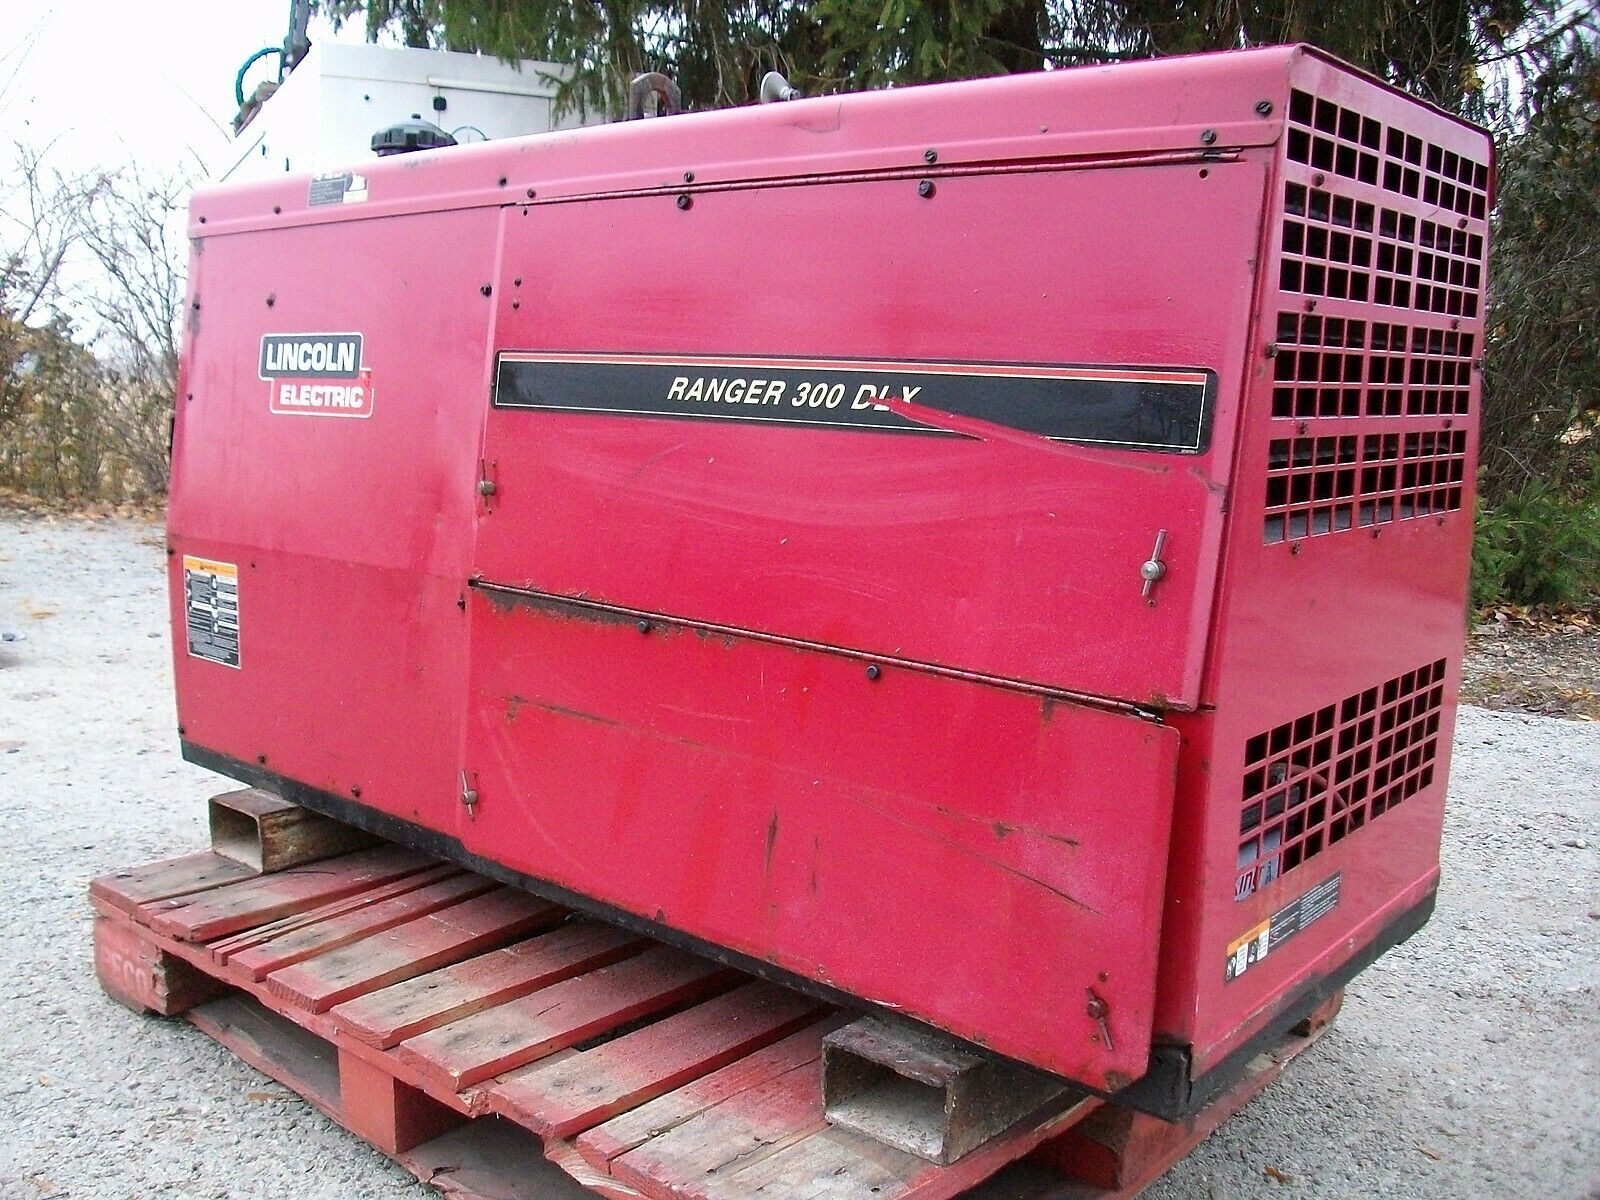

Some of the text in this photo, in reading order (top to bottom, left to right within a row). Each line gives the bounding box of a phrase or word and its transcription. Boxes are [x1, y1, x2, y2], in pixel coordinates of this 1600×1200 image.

[265, 342, 356, 372] LINCOLN
[279, 384, 364, 408] ELECTRIC
[667, 376, 787, 406] RANGER
[791, 382, 846, 409] 300
